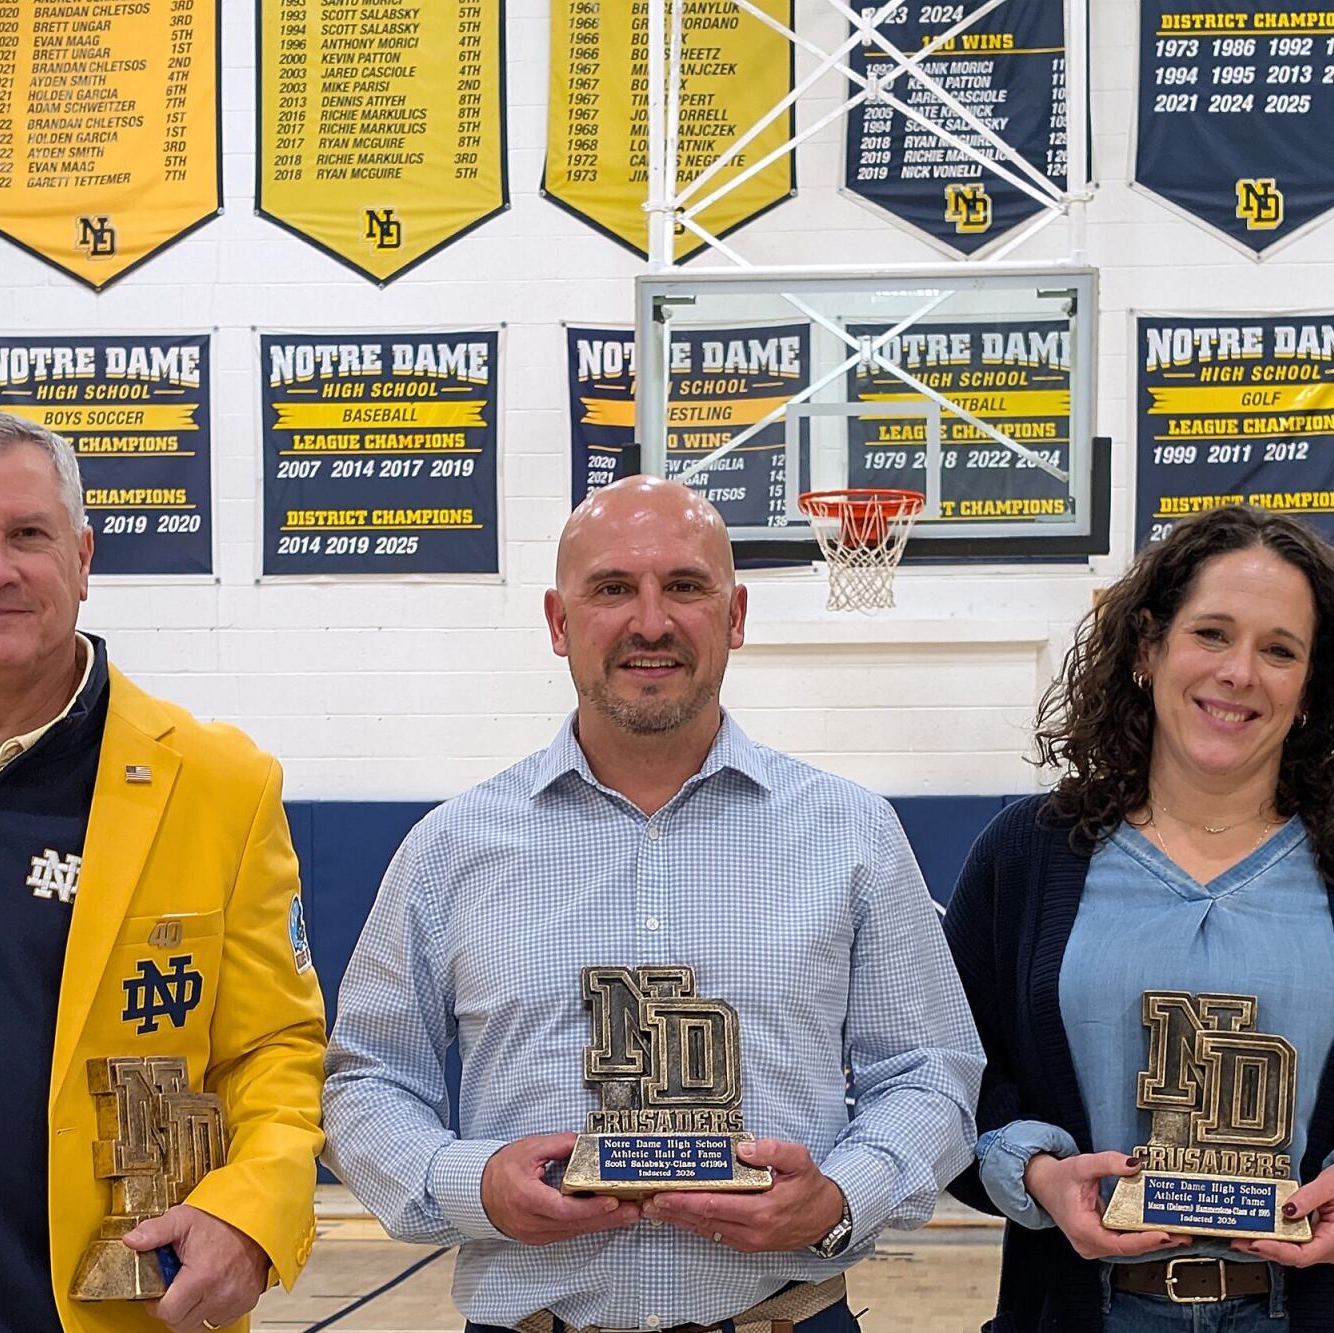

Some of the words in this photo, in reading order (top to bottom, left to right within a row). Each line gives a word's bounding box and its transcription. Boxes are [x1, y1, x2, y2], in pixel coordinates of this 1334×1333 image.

[1161, 14, 1248, 29] DISTRICT
[963, 34, 1013, 50] WINS
[1155, 40, 1199, 58] 1973
[1211, 39, 1255, 57] 1986
[1268, 38, 1313, 57] 1992
[32, 48, 70, 60] BRETT
[73, 47, 111, 59] UNGAR
[171, 43, 191, 54] 1ST
[279, 53, 307, 65] 2000
[321, 53, 356, 64] KEVIN
[359, 52, 401, 64] PATTON
[459, 50, 481, 62] 6TH
[1155, 68, 1198, 85] 1994
[1211, 67, 1255, 85] 1995
[1267, 66, 1312, 84] 2013
[1155, 95, 1198, 113] 2021
[1209, 95, 1253, 113] 2024
[1265, 95, 1311, 113] 2025
[566, 170, 597, 181] 1973
[858, 166, 887, 180] 2019
[901, 165, 931, 179] NICK
[933, 164, 982, 178] VONELLI
[1146, 327, 1264, 373] NOTRE
[270, 345, 380, 388] NOTRE
[392, 342, 489, 387] DAME
[322, 382, 366, 398] HIGH
[371, 381, 439, 397] SCHOOL
[1242, 391, 1282, 407] GOLF
[44, 411, 82, 425] BOYS
[86, 410, 144, 425] SOCCER
[342, 407, 418, 423] BASEBALL
[293, 434, 359, 450] LEAGUE
[364, 432, 465, 449] CHAMPIONS
[967, 450, 1011, 467] 2022
[1153, 445, 1196, 464] 1999
[1207, 444, 1251, 463] 2011
[1264, 442, 1309, 461] 2012
[277, 460, 321, 478] 2007
[331, 460, 374, 478] 2014
[379, 460, 424, 478] 2017
[430, 459, 474, 478] 2019
[103, 516, 147, 534] 2019
[157, 515, 200, 533] 2020
[278, 537, 321, 555] 2014
[325, 537, 369, 555] 2019
[375, 537, 418, 555] 2025
[147, 920, 183, 948] 40
[582, 965, 743, 1111] ND
[1137, 990, 1297, 1152] ND
[587, 1110, 744, 1133] CRUSADERS
[604, 1139, 630, 1148] Notre
[636, 1139, 661, 1148] Dame
[668, 1139, 690, 1149] High
[696, 1140, 727, 1148] School
[611, 1150, 649, 1158] Athletic
[655, 1150, 674, 1158] Hall
[681, 1150, 691, 1158] of
[698, 1150, 721, 1158] Fame
[1133, 1146, 1291, 1179] CRUSADERS
[605, 1160, 626, 1168] Scott
[639, 1169, 671, 1177] Inducted
[676, 1169, 695, 1177] 2026
